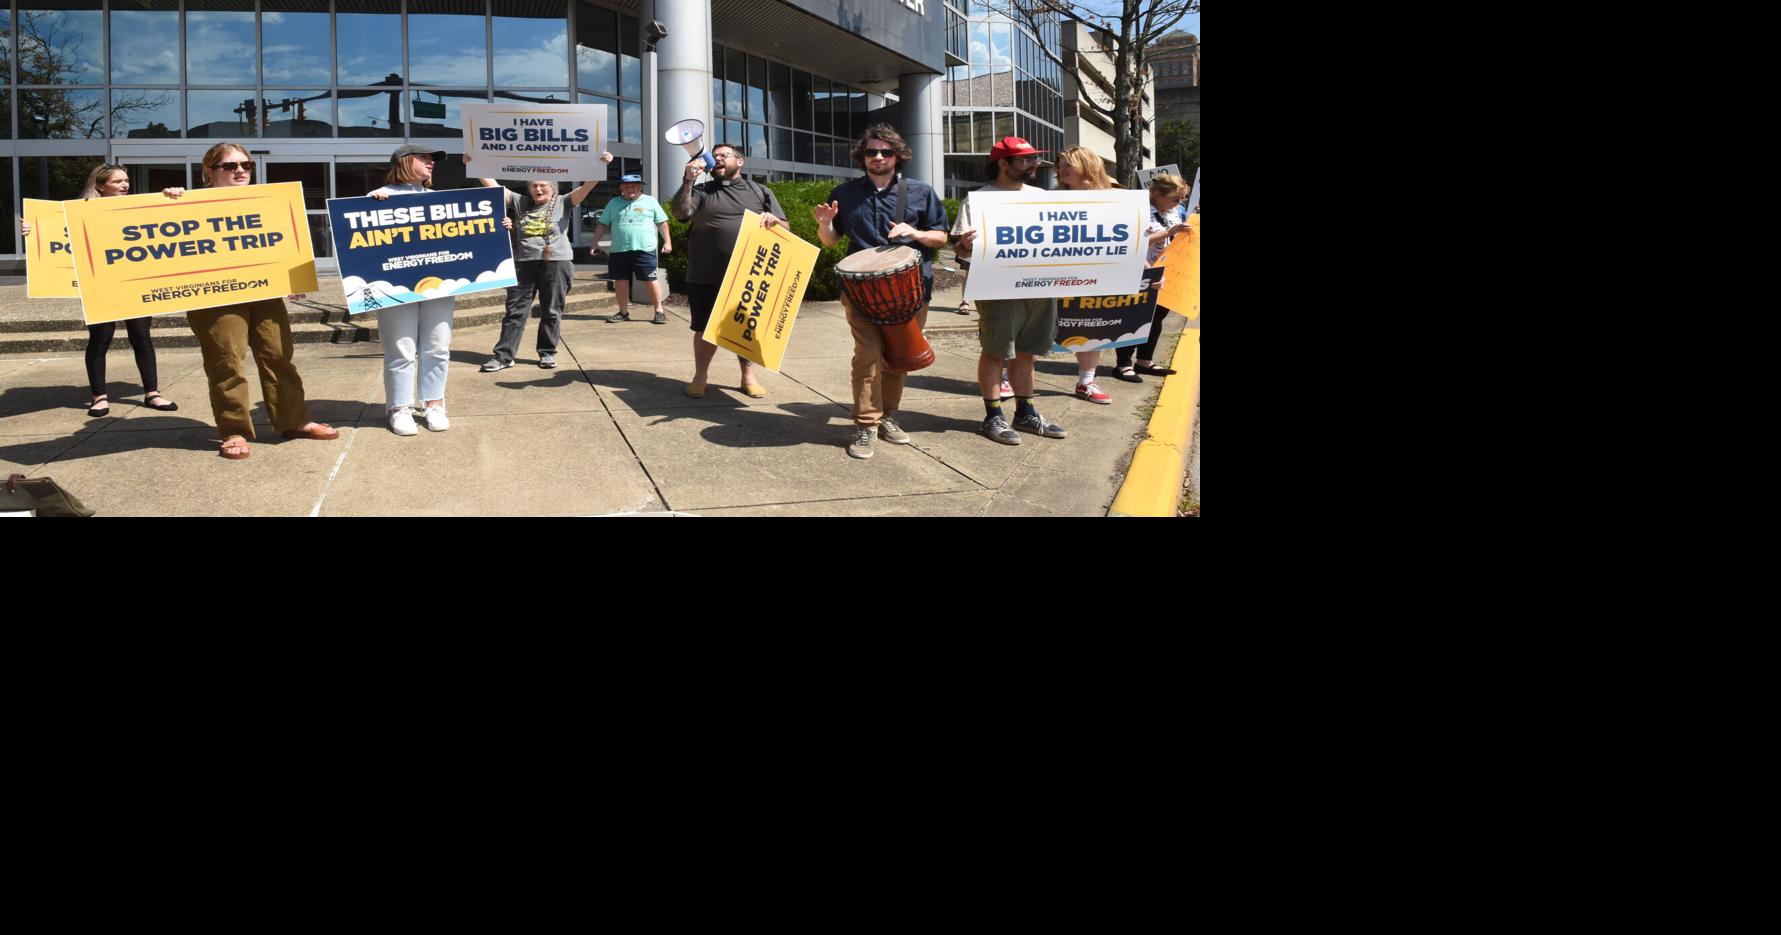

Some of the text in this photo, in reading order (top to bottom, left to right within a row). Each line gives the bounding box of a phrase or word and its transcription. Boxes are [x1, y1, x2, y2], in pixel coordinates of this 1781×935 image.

[513, 118, 517, 126] I
[479, 127, 589, 142] BIG BILLS
[481, 143, 506, 151] AND
[509, 143, 513, 151] I
[516, 143, 567, 152] CANNOT
[344, 200, 493, 229] THESE BILLS
[1039, 211, 1088, 221] I HAVE
[122, 213, 263, 242] STOP THE
[350, 226, 413, 249] AIN'T
[419, 218, 496, 241] RIGHT!
[995, 223, 1129, 245] BIG BILLS
[105, 231, 284, 265] POWER TRIP
[995, 245, 1128, 259] AND I CANNOT LIE
[382, 251, 473, 271] ENERGY FREEDOM
[142, 279, 269, 303] ENERGY FREEDOM
[176, 281, 221, 290] VIRGINIANS
[733, 245, 768, 324] STOP THE
[742, 242, 782, 342] POWER TRIP
[1015, 279, 1097, 288] ENERGY FREEDOM
[775, 307, 789, 340] ENERGY
[787, 270, 802, 308] FREEDOM
[1079, 291, 1149, 309] RIGHT!
[1078, 319, 1122, 328] FREEDOM
